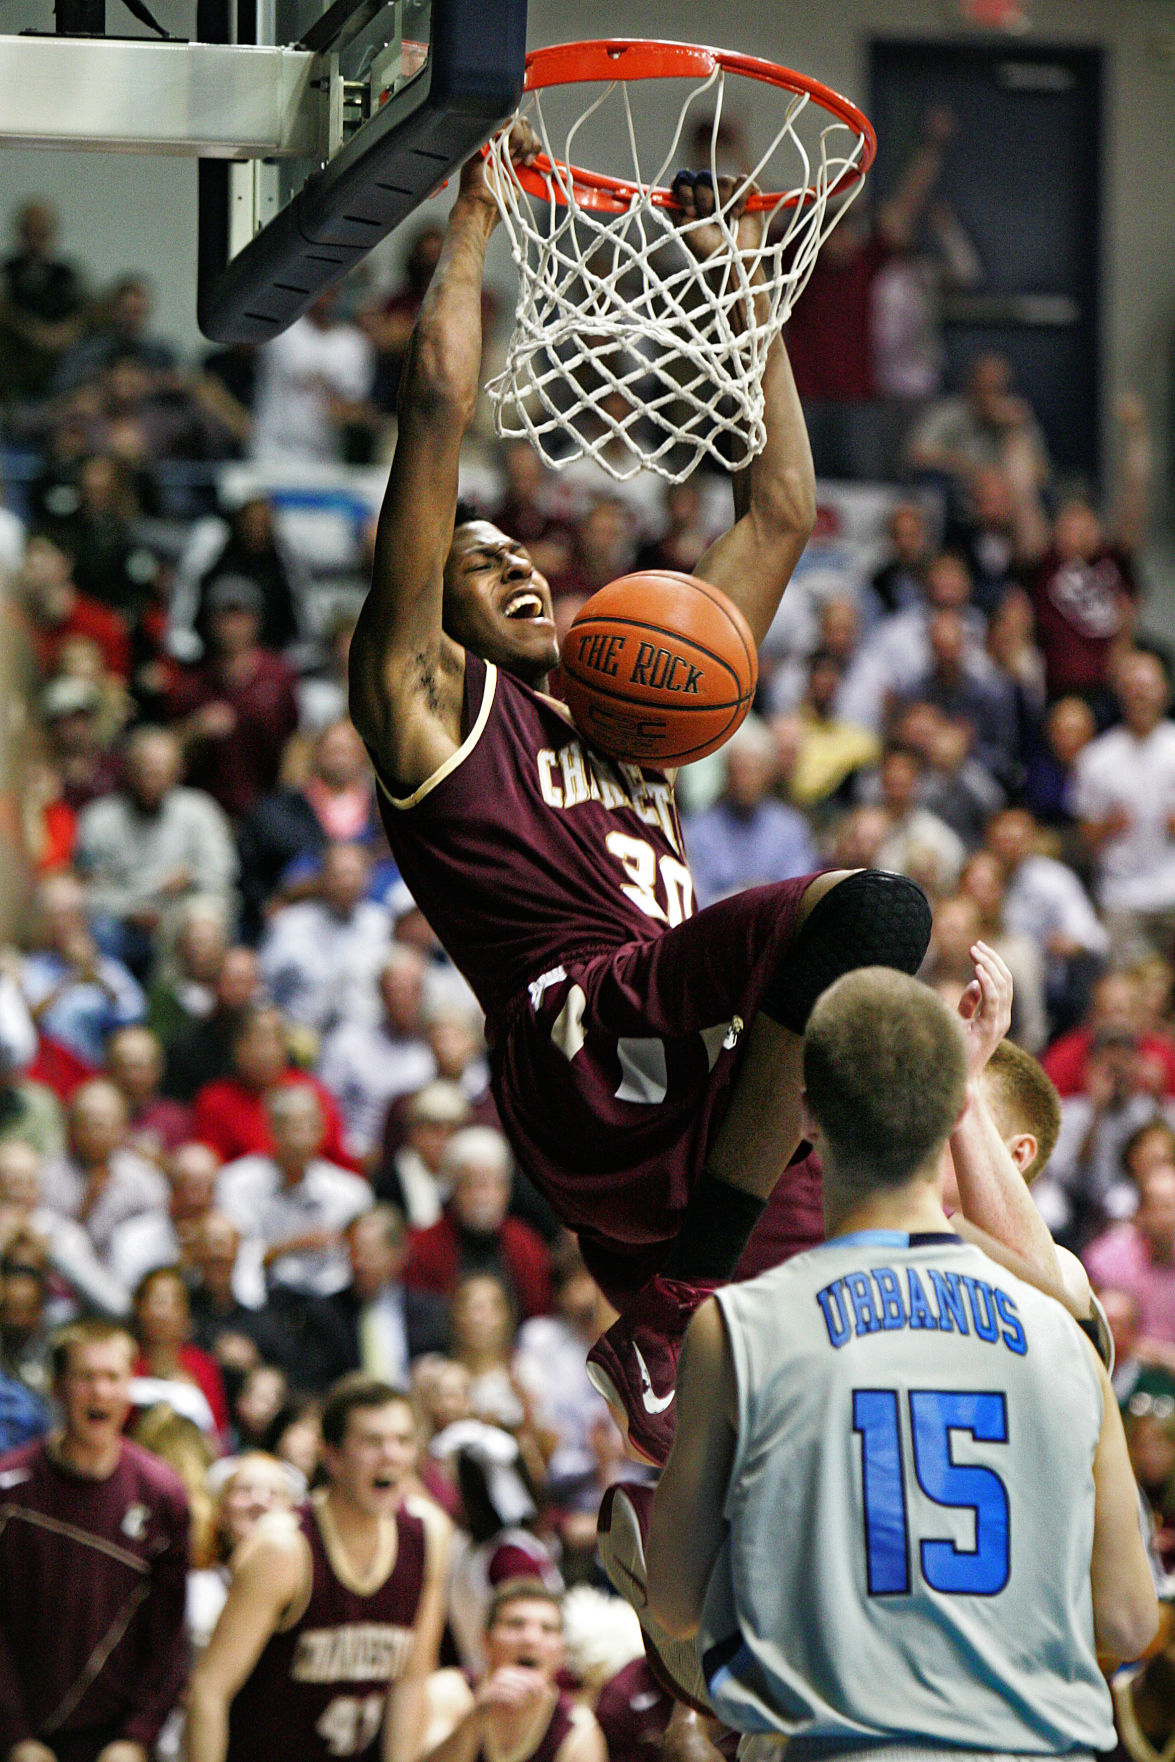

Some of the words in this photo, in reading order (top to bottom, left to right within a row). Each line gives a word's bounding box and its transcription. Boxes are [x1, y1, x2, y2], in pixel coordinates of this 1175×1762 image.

[578, 635, 626, 677] THE
[630, 641, 704, 694] ROCK
[605, 830, 693, 929] 30
[816, 1267, 1029, 1356] URBANUS
[851, 1388, 1010, 1595] 15
